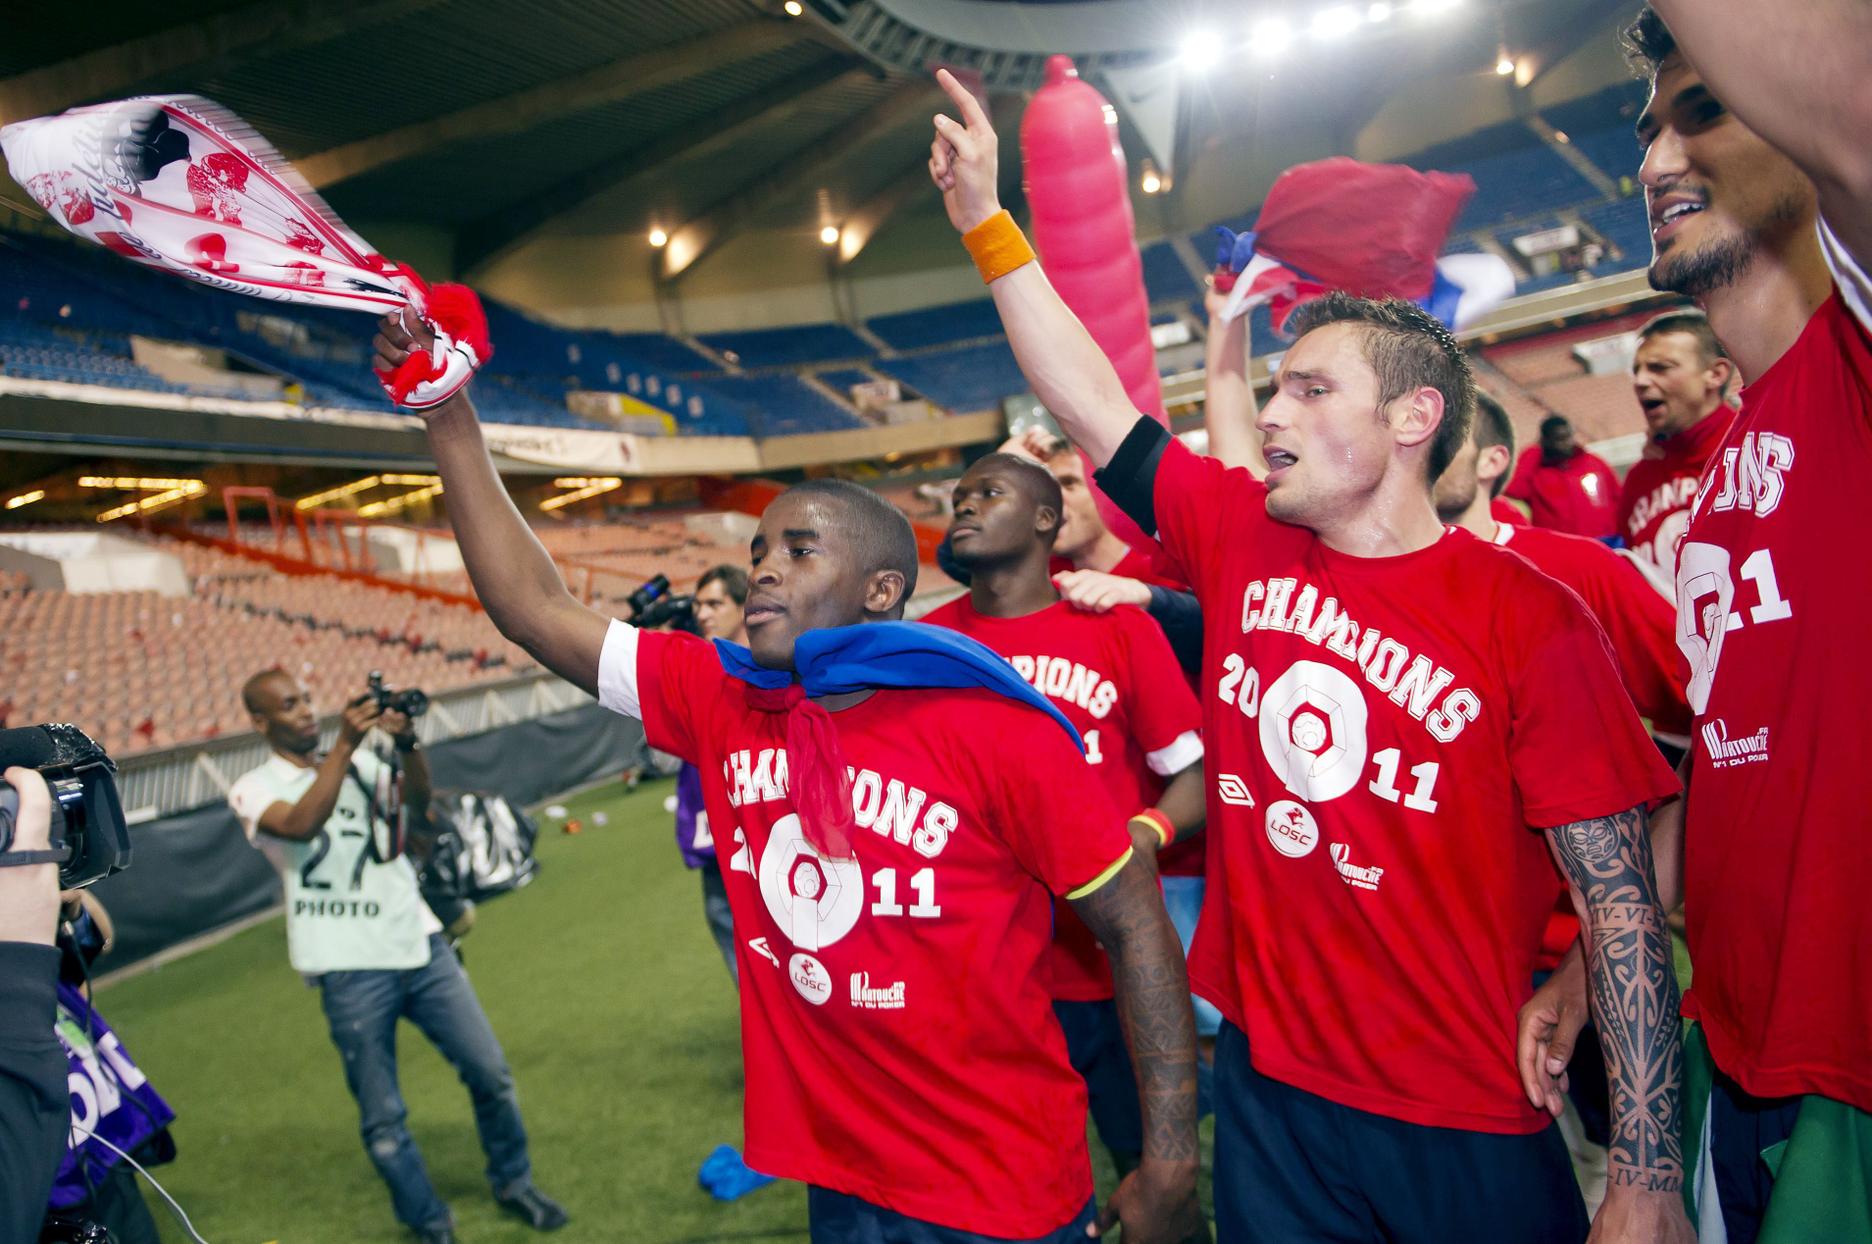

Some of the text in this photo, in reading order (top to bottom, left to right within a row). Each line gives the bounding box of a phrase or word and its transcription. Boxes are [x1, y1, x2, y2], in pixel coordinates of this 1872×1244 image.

[1218, 653, 1440, 813] 20 11
[1271, 819, 1312, 846] LOSC
[872, 868, 941, 918] 11
[295, 899, 380, 917] PHOTO
[794, 972, 826, 992] LOSC
